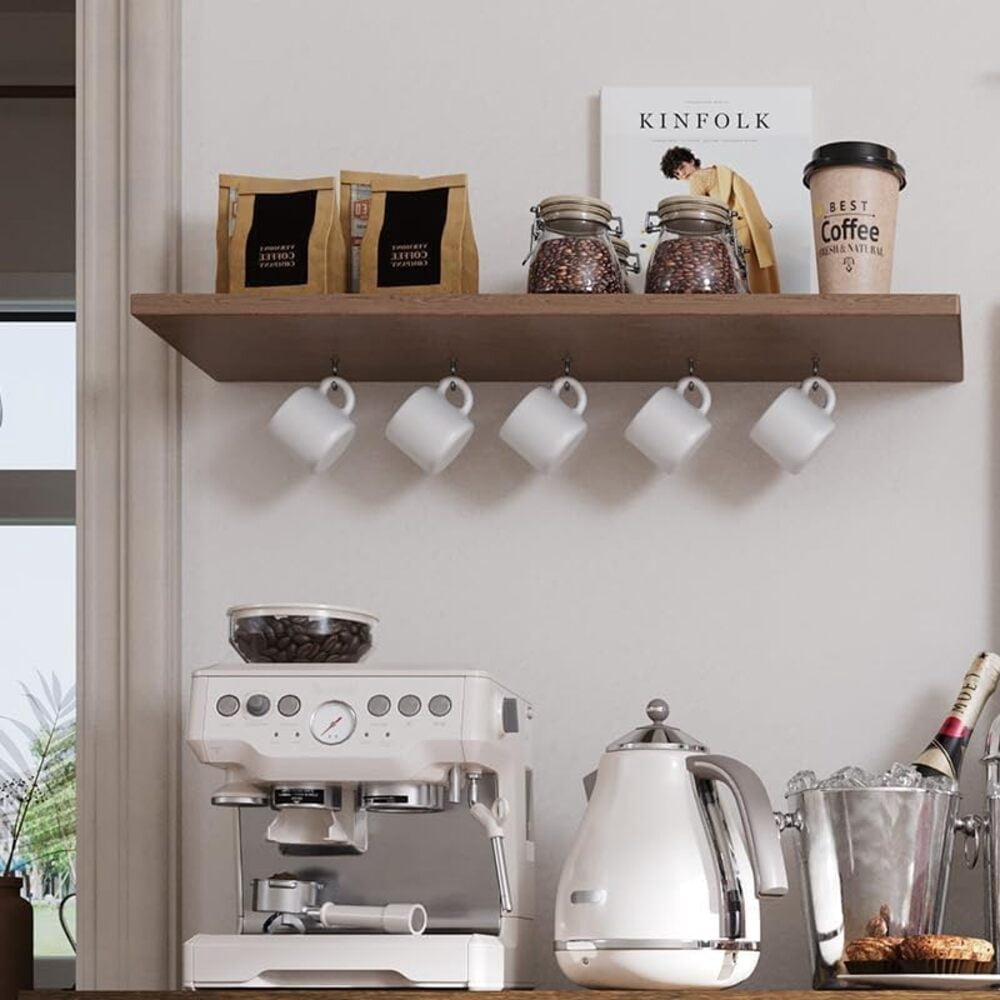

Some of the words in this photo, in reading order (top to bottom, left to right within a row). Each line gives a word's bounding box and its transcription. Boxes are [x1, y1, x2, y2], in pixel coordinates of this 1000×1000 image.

[639, 111, 770, 130] KINFOLK
[829, 200, 868, 213] BEST
[821, 217, 880, 243] Coffee
